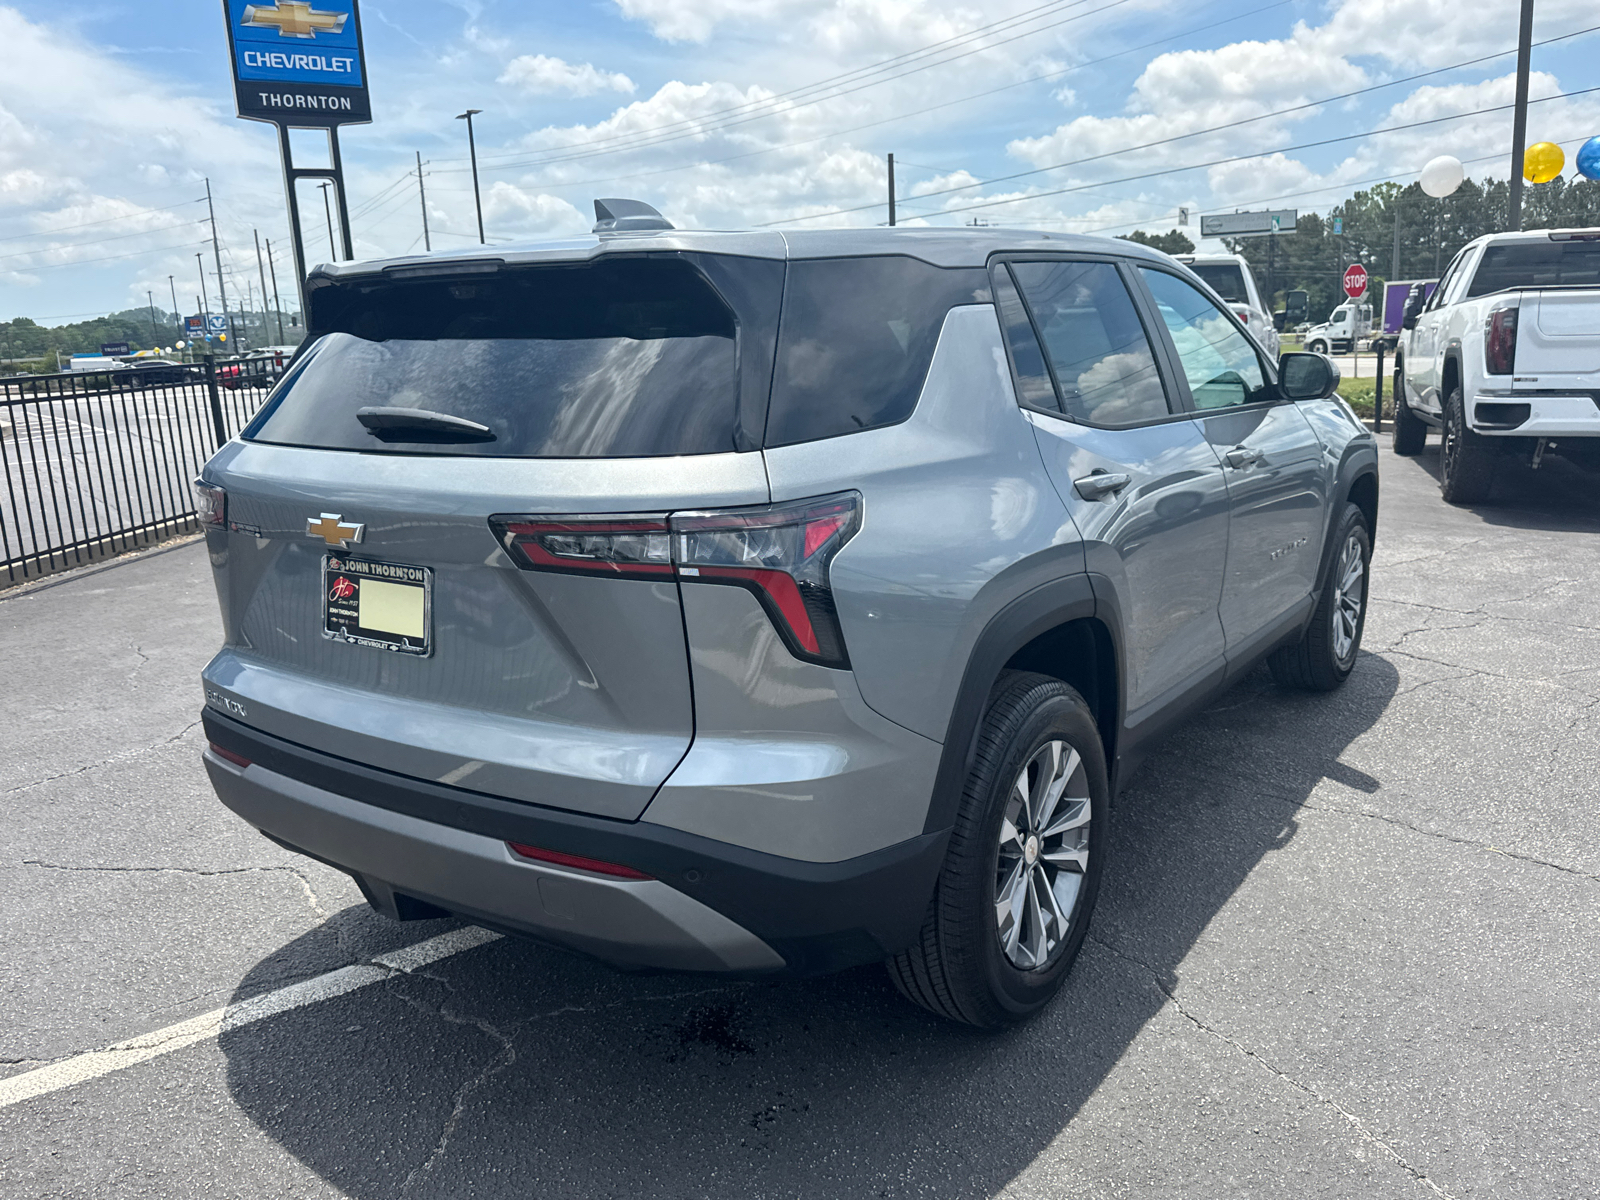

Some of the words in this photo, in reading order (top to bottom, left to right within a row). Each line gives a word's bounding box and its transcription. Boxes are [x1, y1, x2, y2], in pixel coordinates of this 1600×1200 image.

[244, 51, 354, 73] CHEVROLET
[259, 92, 351, 110] THORNTON
[1345, 274, 1366, 289] STOP
[345, 560, 369, 574] JOHN
[370, 564, 423, 580] THORNTON
[338, 608, 359, 617] THORNTON
[357, 638, 388, 649] CHEVROLET
